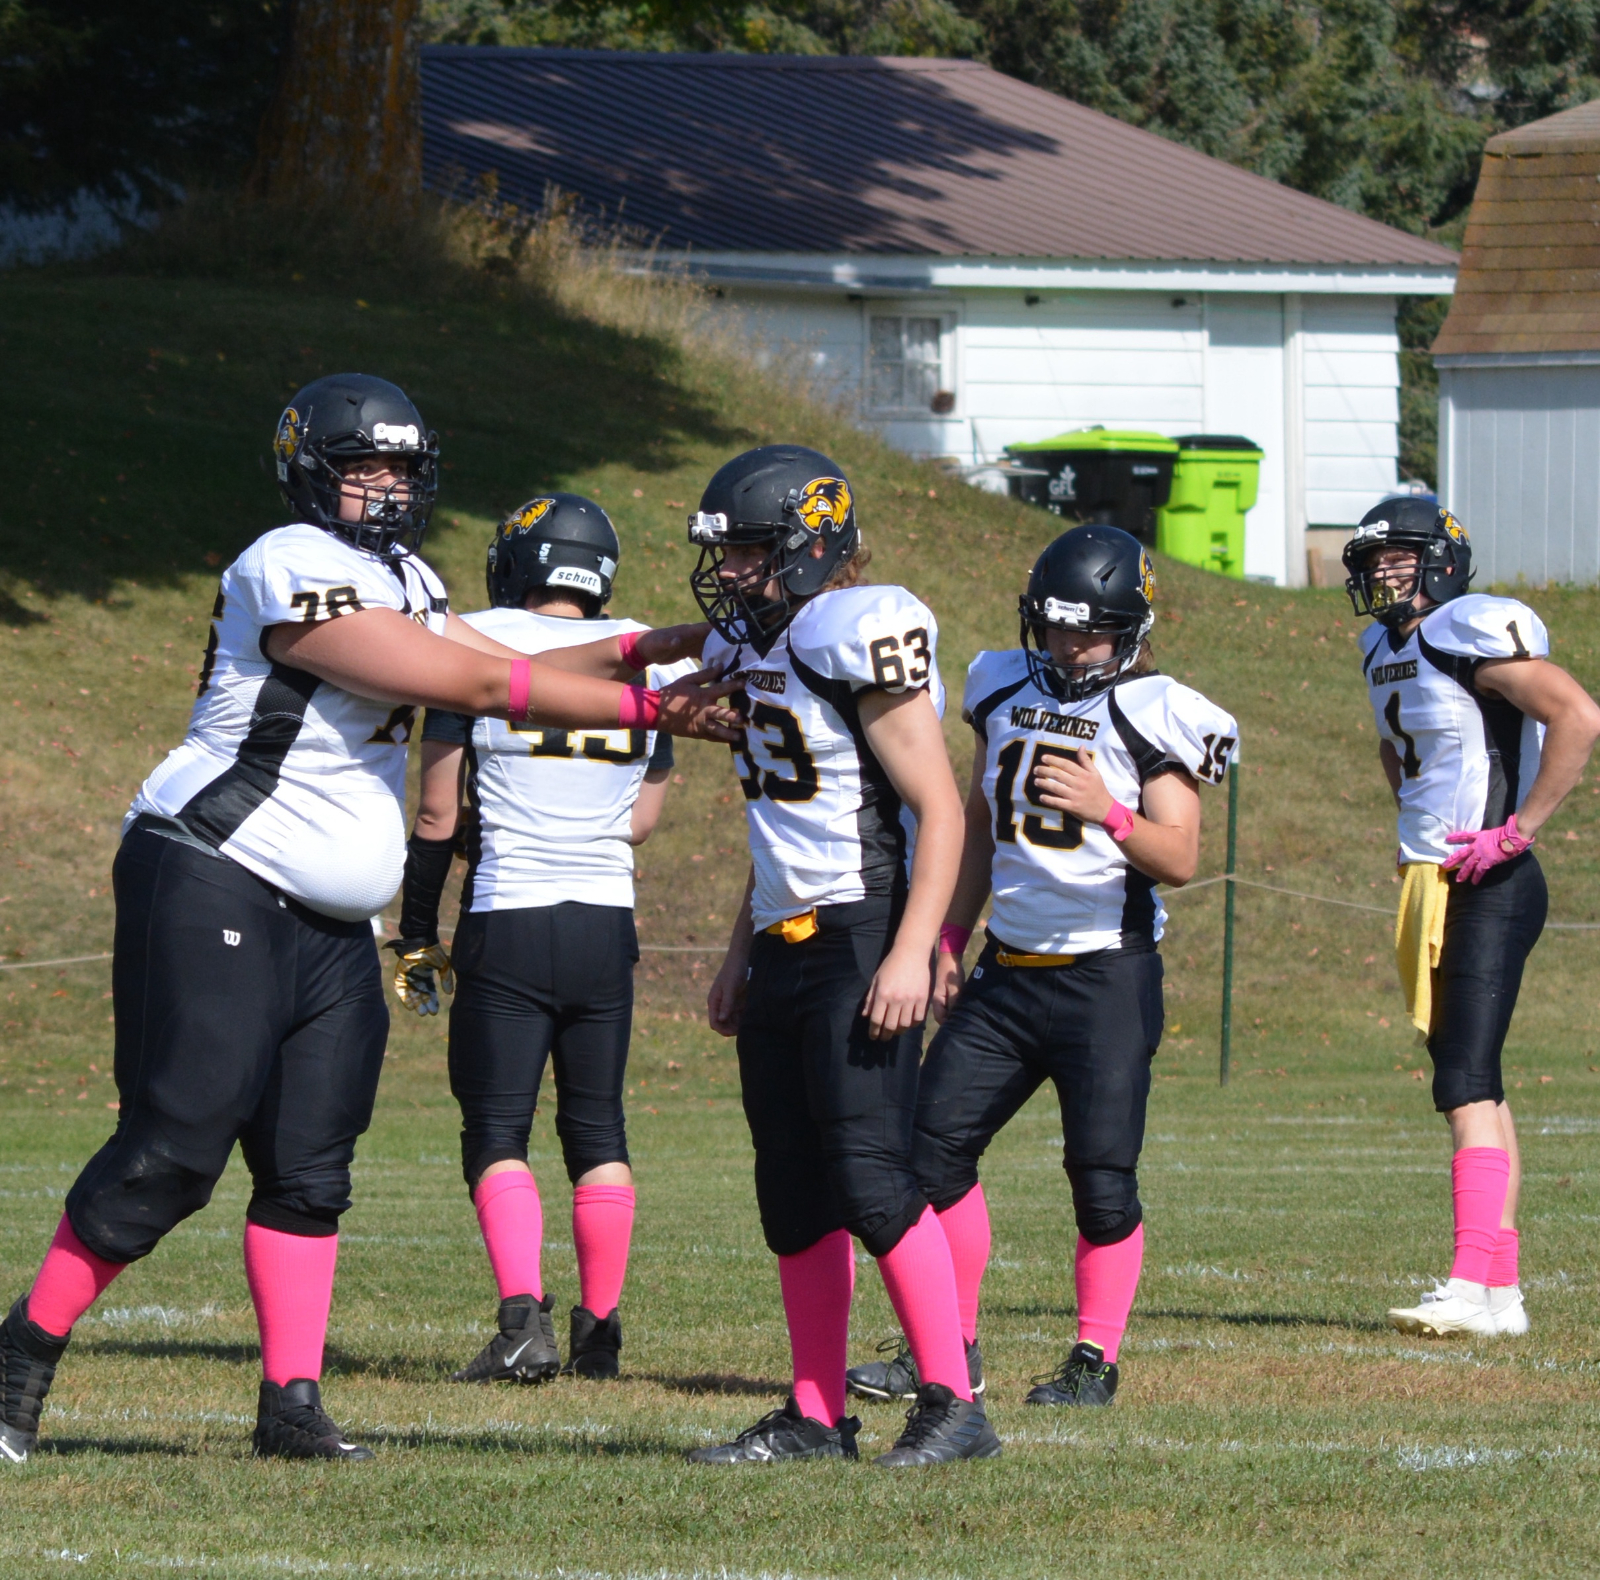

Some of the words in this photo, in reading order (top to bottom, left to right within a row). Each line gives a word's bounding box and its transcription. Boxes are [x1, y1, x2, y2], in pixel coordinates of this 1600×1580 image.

[1049, 479, 1076, 495] GFL
[557, 571, 598, 587] schutt
[868, 626, 931, 689] 63
[1506, 620, 1530, 657] 1
[1010, 705, 1100, 741] WOLVERINES
[1384, 690, 1421, 779] 1
[1197, 732, 1237, 783] 15
[994, 737, 1096, 852] 15
